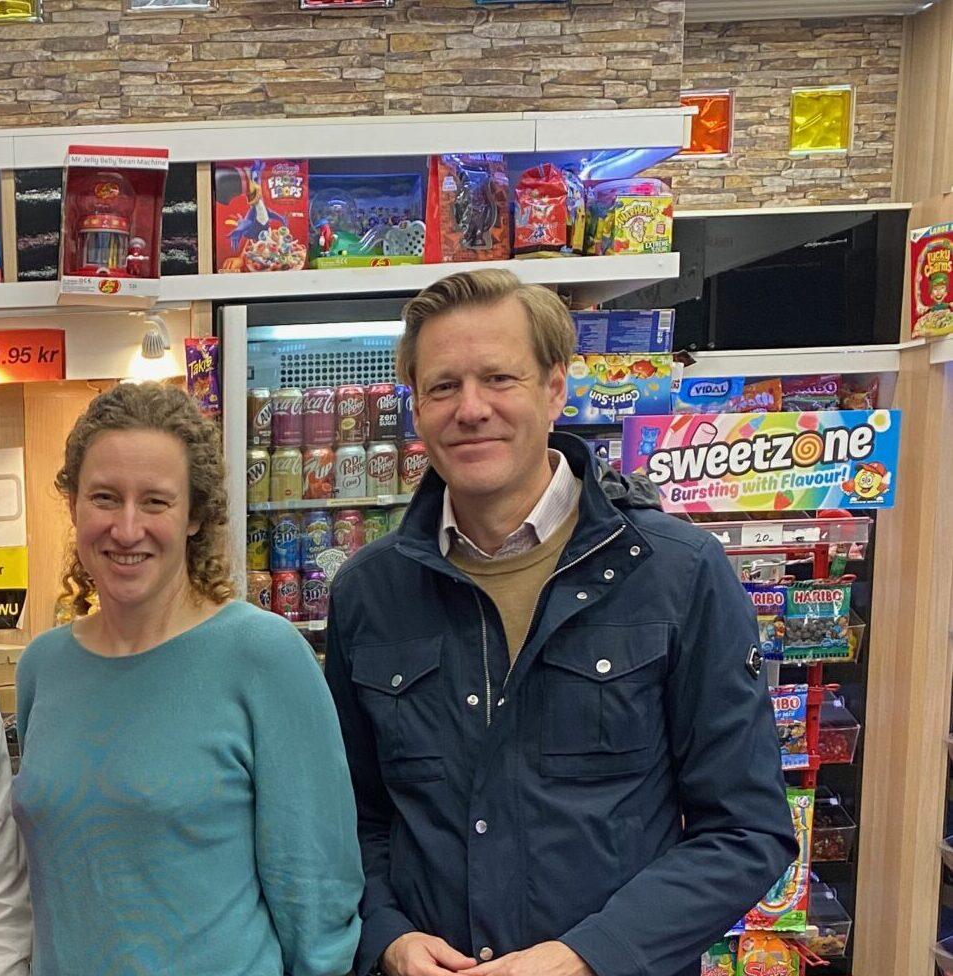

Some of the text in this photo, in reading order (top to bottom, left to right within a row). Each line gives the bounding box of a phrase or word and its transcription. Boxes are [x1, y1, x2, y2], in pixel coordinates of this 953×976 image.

[38, 348, 59, 363] kr
[188, 356, 213, 379] Takis
[695, 383, 727, 395] VIDAL
[589, 390, 640, 406] Capri-Sun
[648, 425, 874, 484] sweetzone
[671, 466, 848, 503] Bursting with Flavour!
[748, 591, 784, 605] RIBO
[794, 589, 844, 604] HARIBO
[774, 696, 801, 710] IBO
